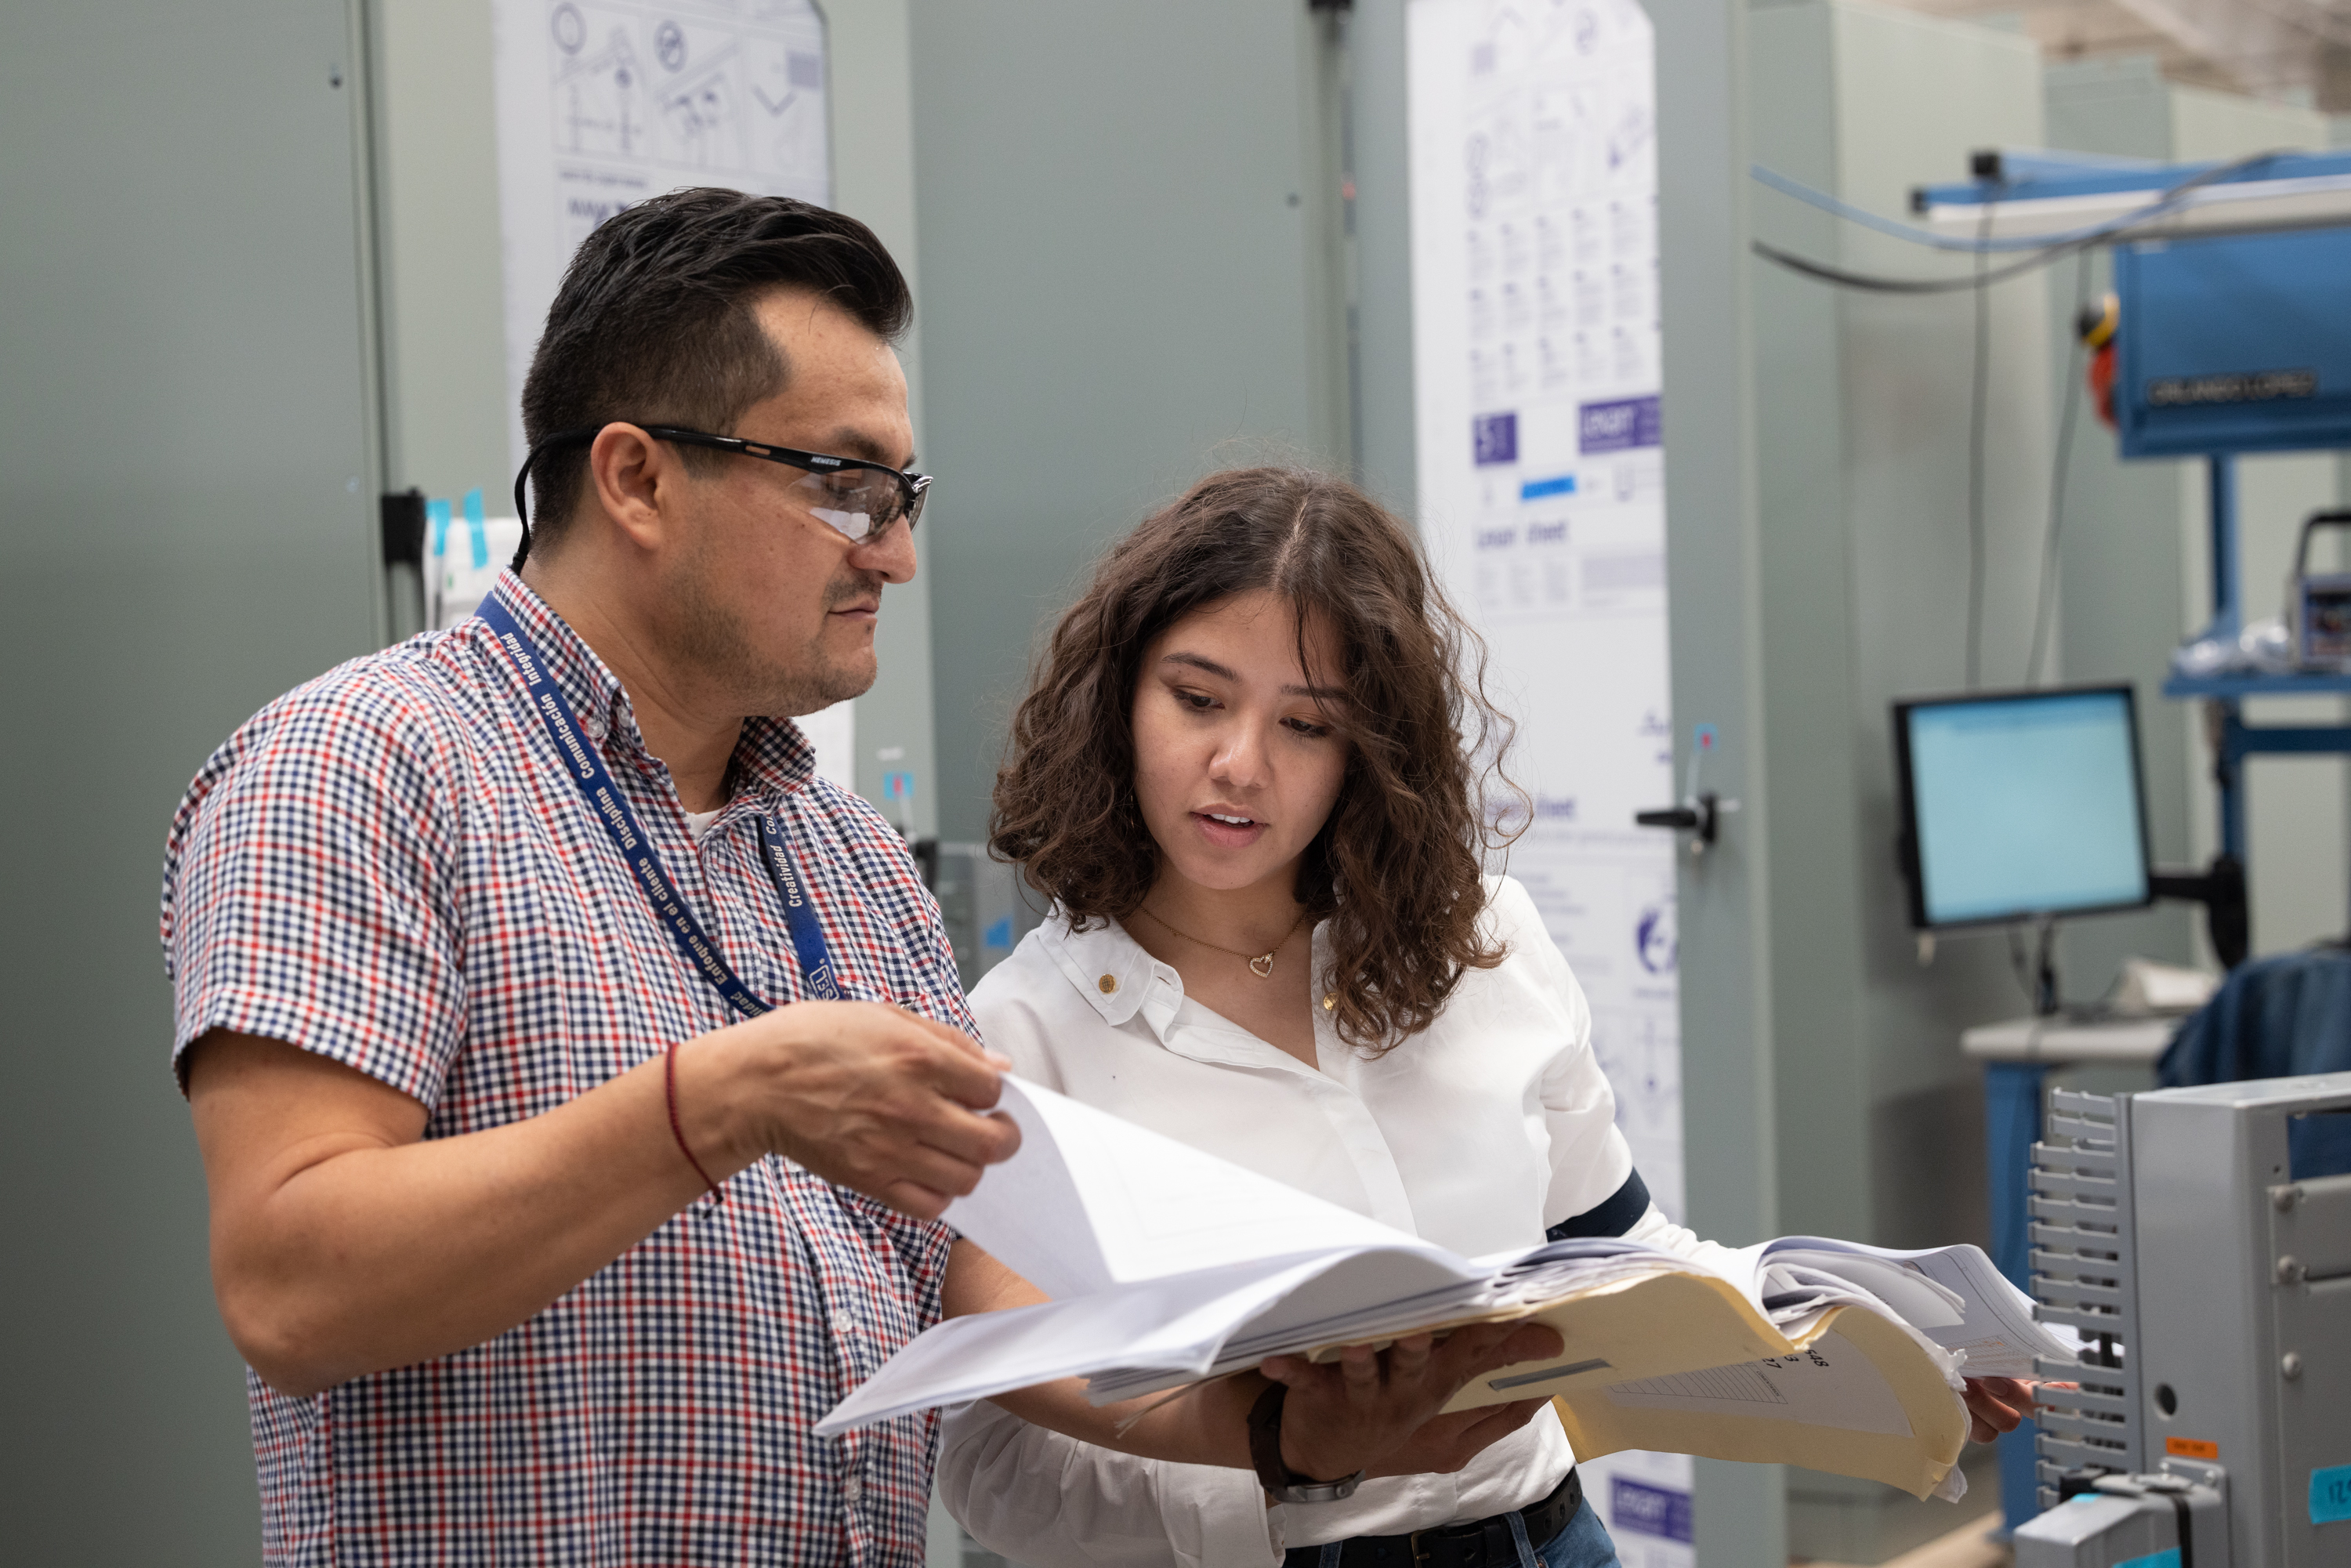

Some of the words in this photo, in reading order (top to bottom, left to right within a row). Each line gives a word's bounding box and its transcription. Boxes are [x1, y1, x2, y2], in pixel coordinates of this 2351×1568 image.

[811, 457, 842, 466] NEMESIS
[500, 632, 542, 686] Integridad
[540, 693, 595, 779] Comunicación
[596, 786, 637, 850] Disciplina
[639, 857, 668, 901] cliente
[770, 845, 803, 907] Creatividad
[663, 902, 679, 916] el
[676, 916, 691, 934] en
[688, 935, 728, 985] Enfoque
[730, 990, 766, 1016] lidad
